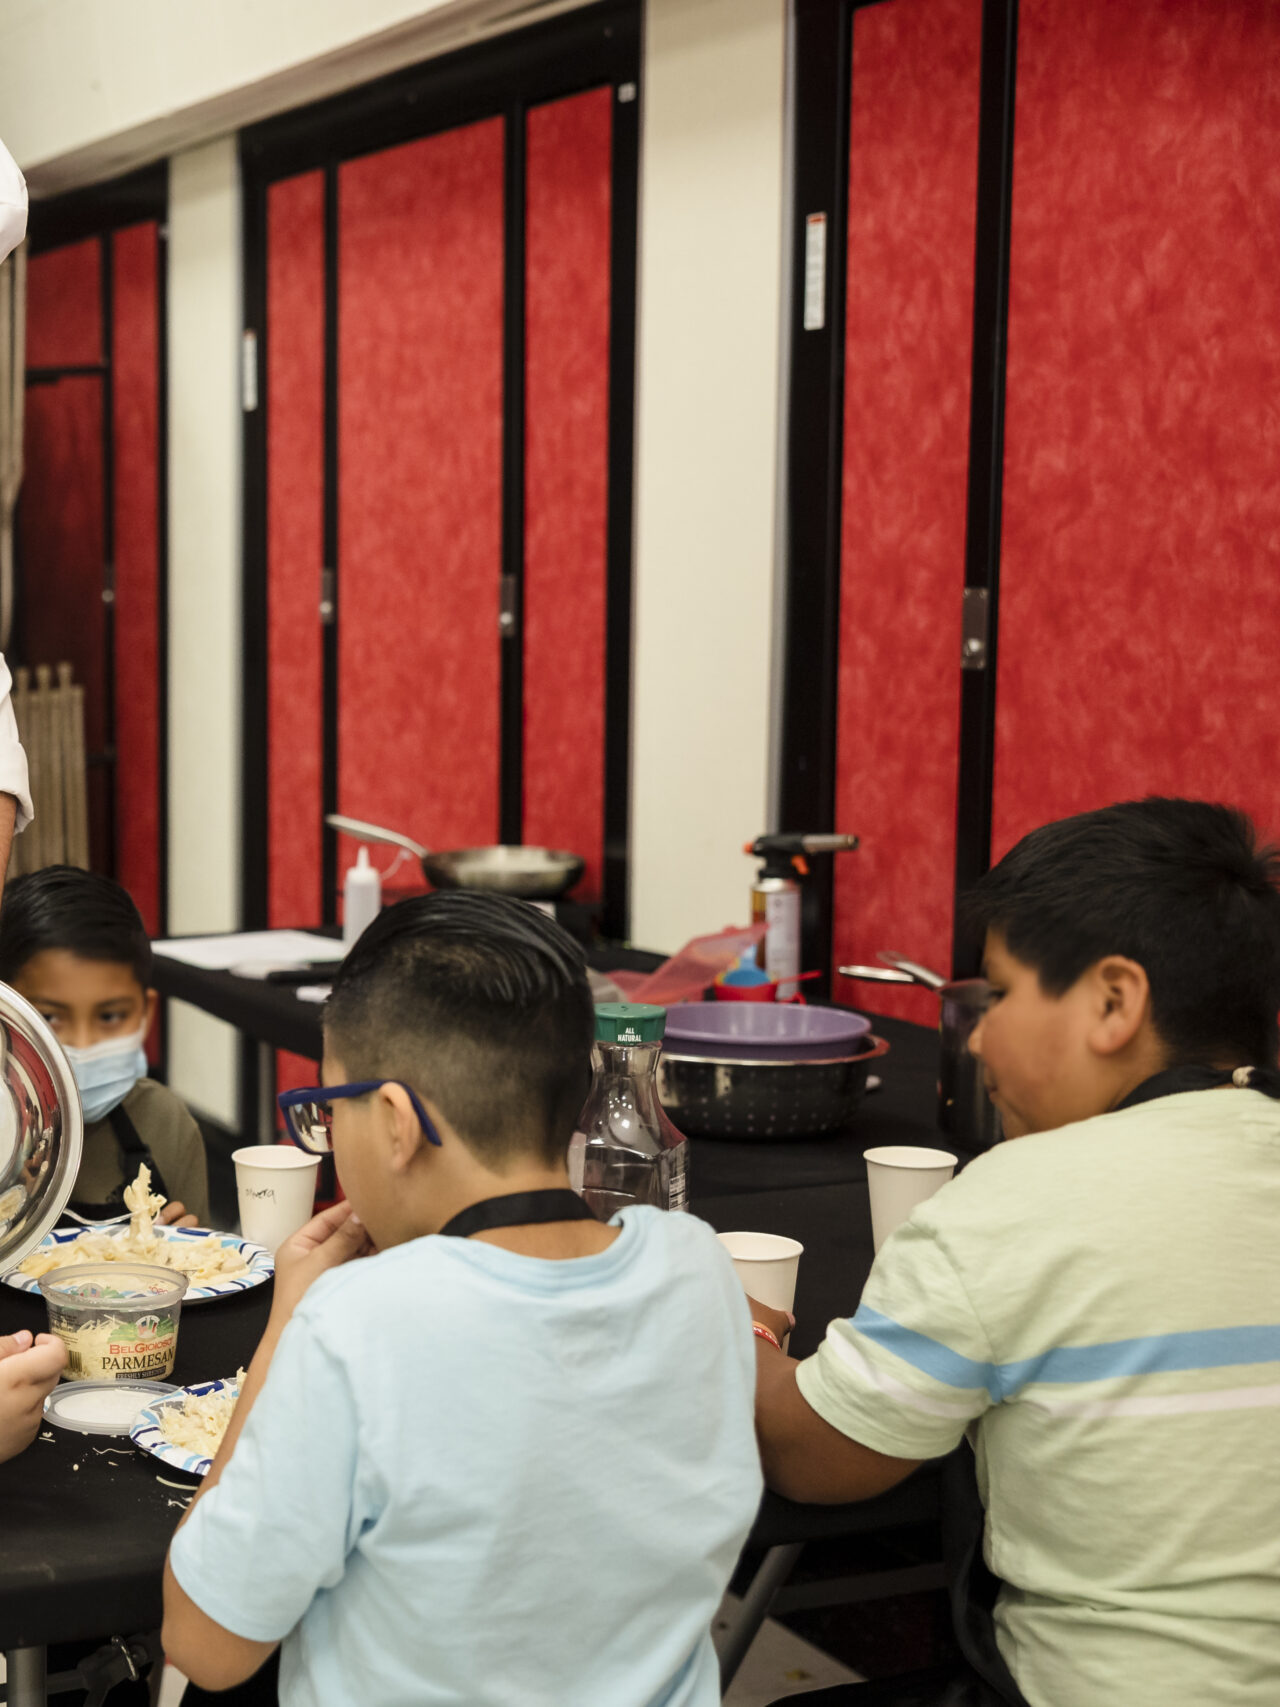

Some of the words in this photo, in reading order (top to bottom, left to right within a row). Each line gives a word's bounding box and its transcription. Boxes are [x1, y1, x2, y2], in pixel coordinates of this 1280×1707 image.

[625, 1027, 635, 1035] ALL
[617, 1034, 642, 1042] NATURAL
[102, 1346, 175, 1370] PARMESAN
